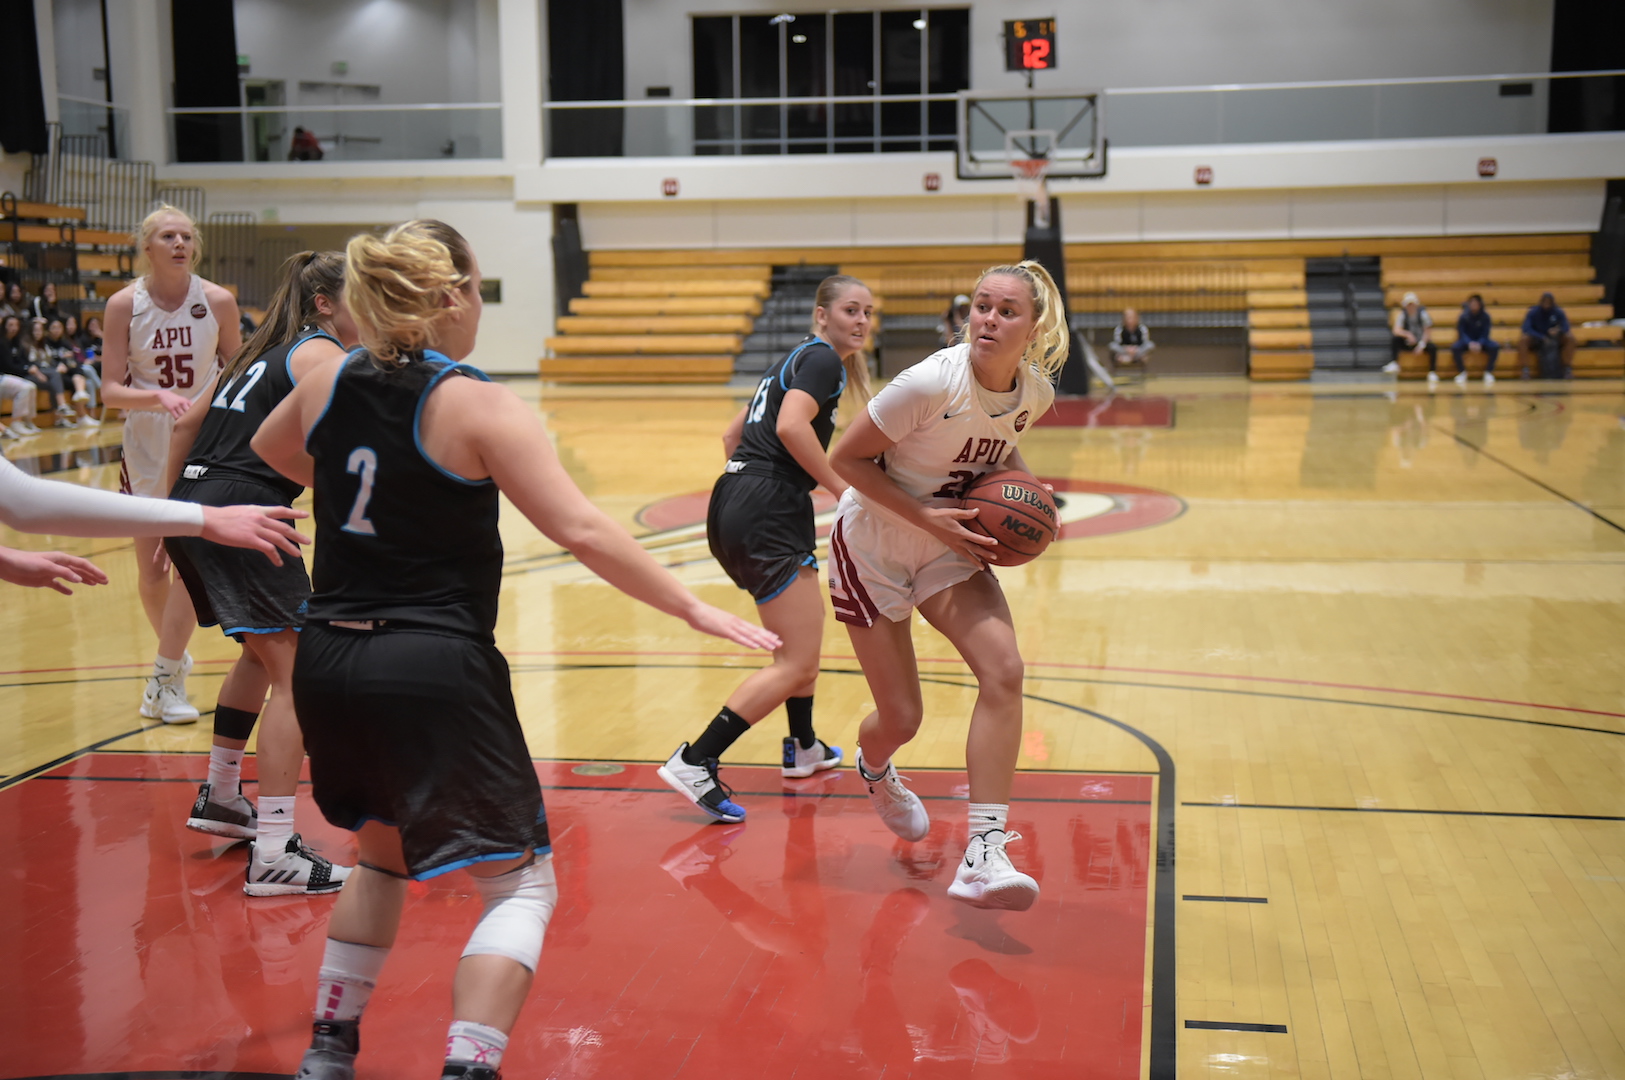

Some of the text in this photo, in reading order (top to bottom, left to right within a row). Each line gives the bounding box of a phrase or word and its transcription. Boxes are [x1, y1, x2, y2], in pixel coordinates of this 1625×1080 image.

[1022, 38, 1050, 69] 12
[151, 326, 192, 350] APU
[154, 354, 194, 389] 35
[952, 437, 1007, 466] APU
[340, 446, 378, 536] 2
[932, 469, 986, 498] 2
[1001, 484, 1056, 521] Wilson
[1001, 515, 1044, 543] NCAA
